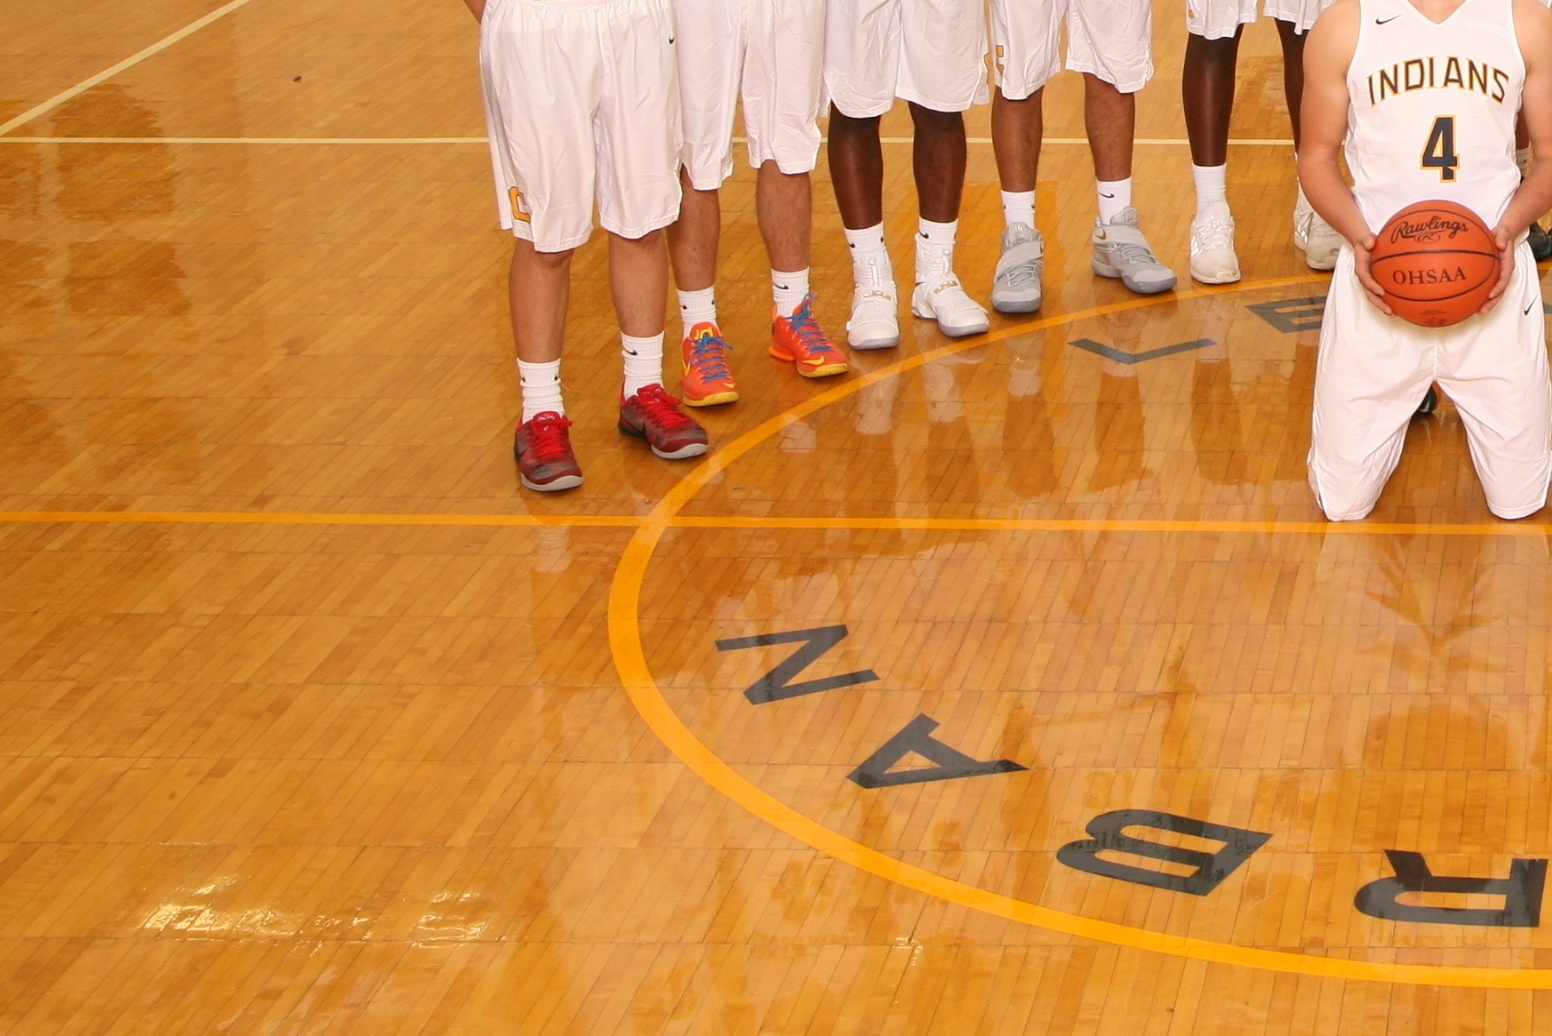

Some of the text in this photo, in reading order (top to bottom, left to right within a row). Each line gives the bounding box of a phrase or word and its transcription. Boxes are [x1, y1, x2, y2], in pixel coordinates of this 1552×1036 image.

[1365, 55, 1510, 108] INDIANS
[1418, 114, 1461, 184] 4
[1390, 215, 1469, 244] Rawlings
[1392, 266, 1467, 285] OHSAA
